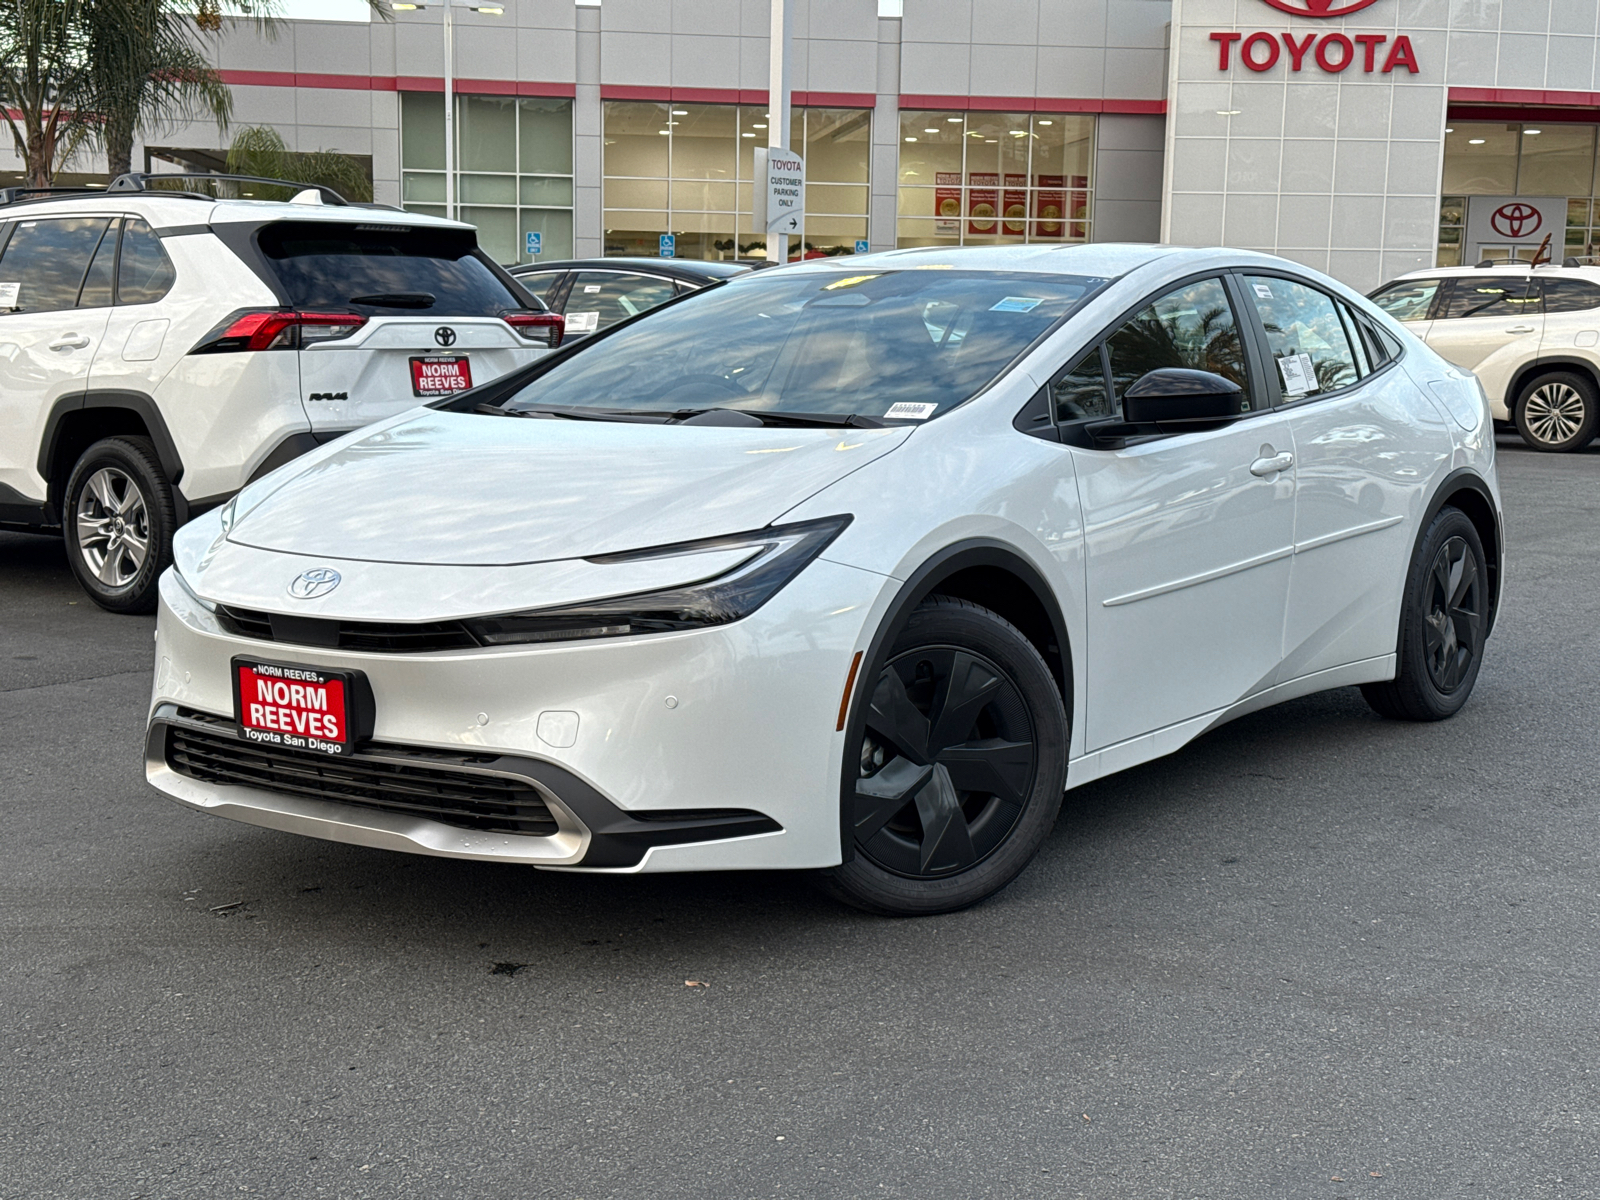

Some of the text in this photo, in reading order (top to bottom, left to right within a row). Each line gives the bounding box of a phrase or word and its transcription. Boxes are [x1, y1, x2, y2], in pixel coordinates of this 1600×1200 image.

[1209, 31, 1420, 74] TOYOTA
[771, 159, 802, 172] TOYOTA
[770, 176, 803, 187] CUSTOMER
[773, 187, 799, 197] PARKING
[778, 199, 794, 207] ONLY
[421, 364, 460, 377] NORM
[419, 376, 466, 389] REEVES
[308, 391, 349, 402] RAV4
[419, 389, 439, 397] Toyota
[257, 664, 318, 682] NORM REEVES
[256, 678, 328, 712] NORM
[249, 702, 339, 738] REEVES
[243, 727, 342, 754] Toyota San Diego
